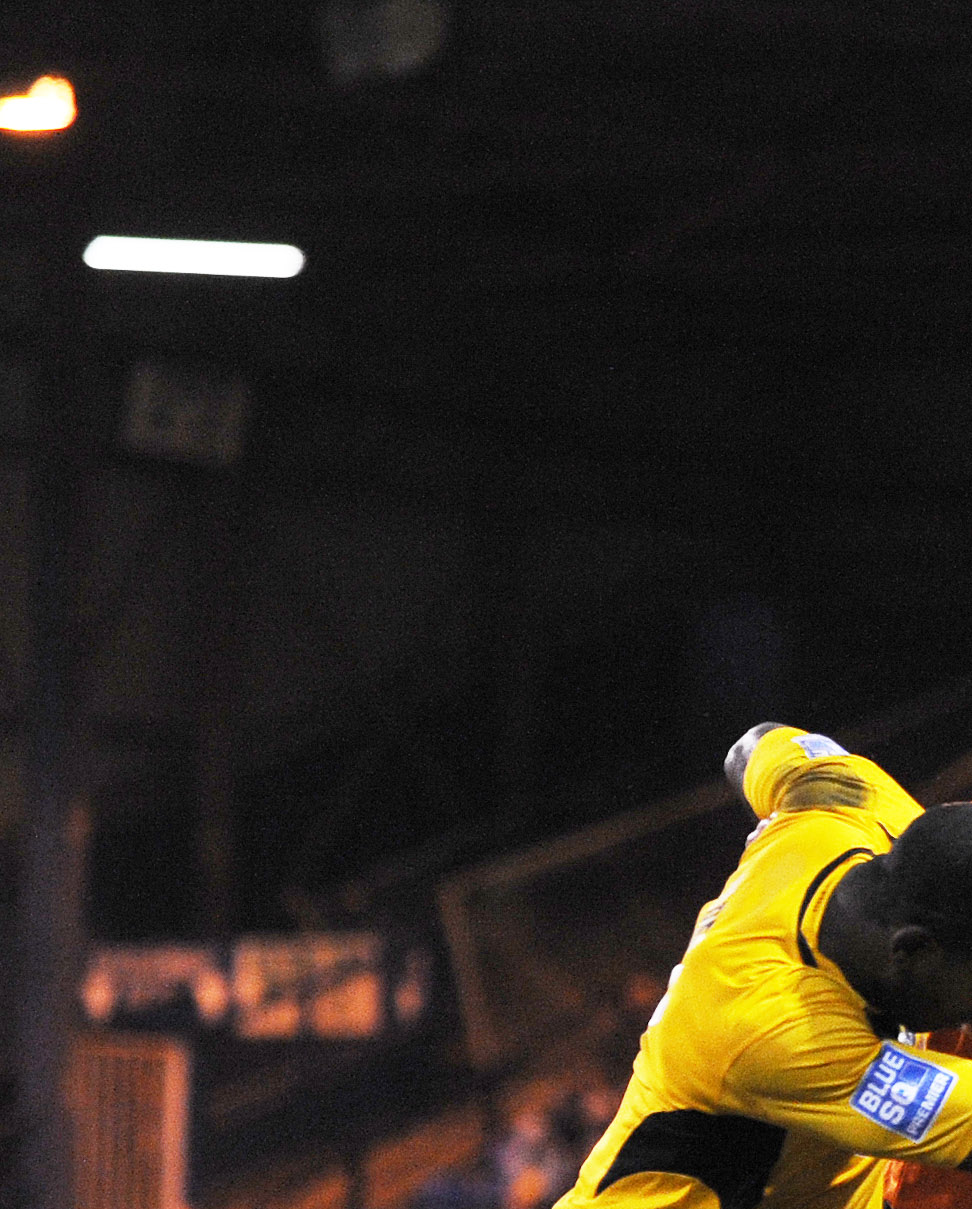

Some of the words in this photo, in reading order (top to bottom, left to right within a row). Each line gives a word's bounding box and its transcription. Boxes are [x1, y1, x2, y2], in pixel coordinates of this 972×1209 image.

[858, 1051, 905, 1113] BLUE
[878, 1081, 918, 1125] SQ
[906, 1072, 950, 1134] PREMIER
